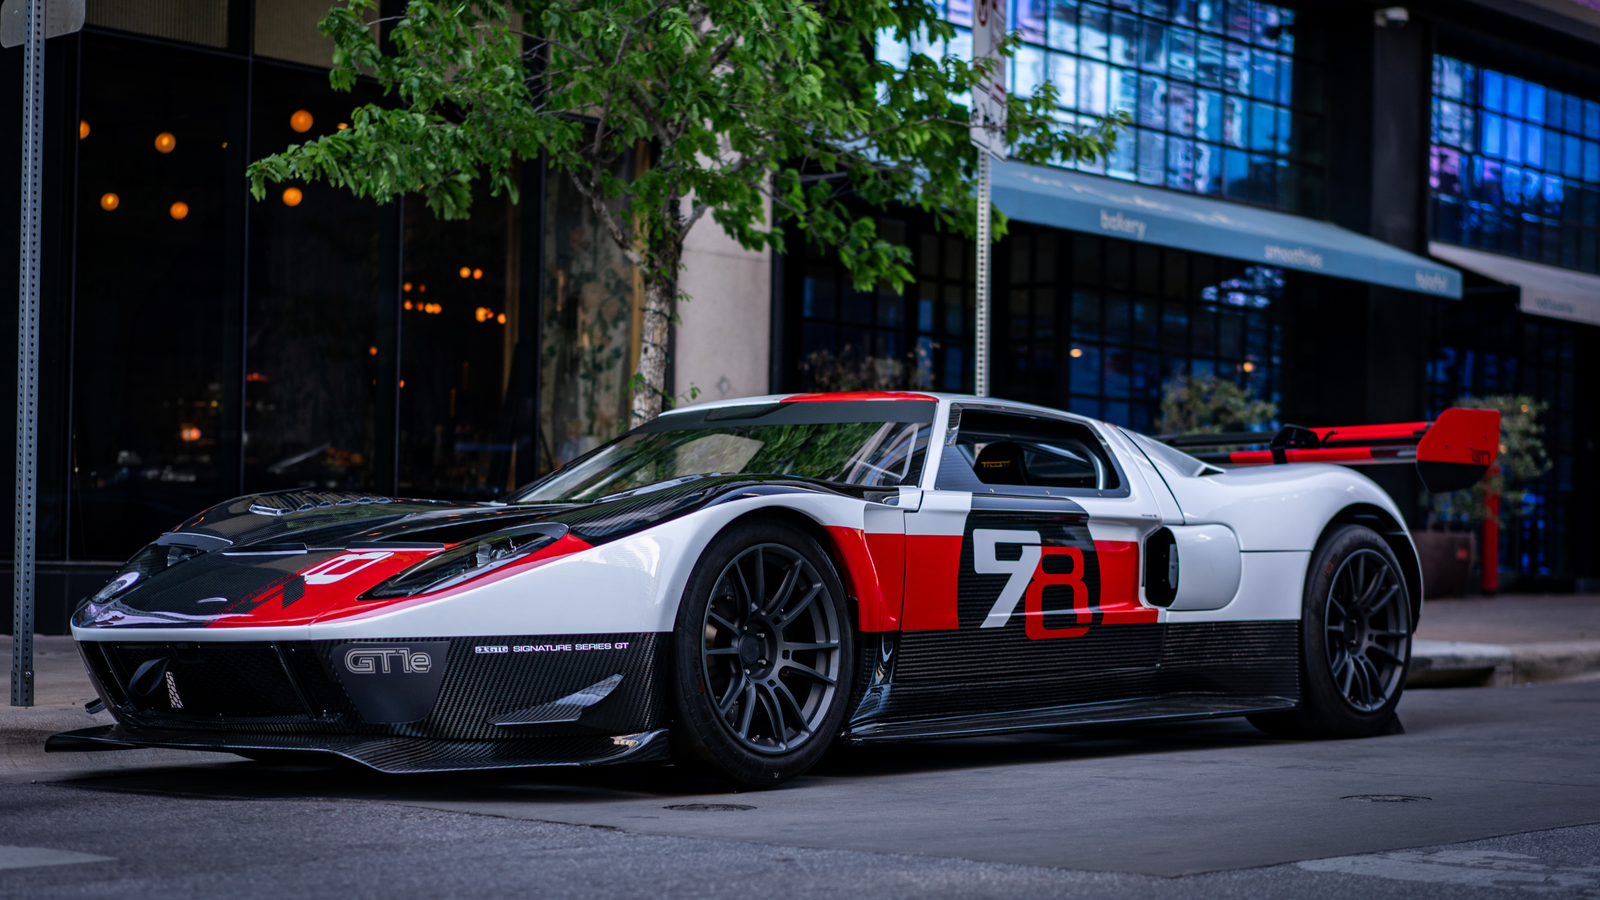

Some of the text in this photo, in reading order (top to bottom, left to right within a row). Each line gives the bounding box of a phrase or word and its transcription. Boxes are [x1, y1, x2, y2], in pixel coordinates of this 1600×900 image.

[1100, 209, 1146, 240] bakery
[972, 528, 1093, 640] 98
[512, 644, 572, 653] SIGNATURE
[575, 643, 611, 651] SERIES
[614, 642, 629, 650] GT
